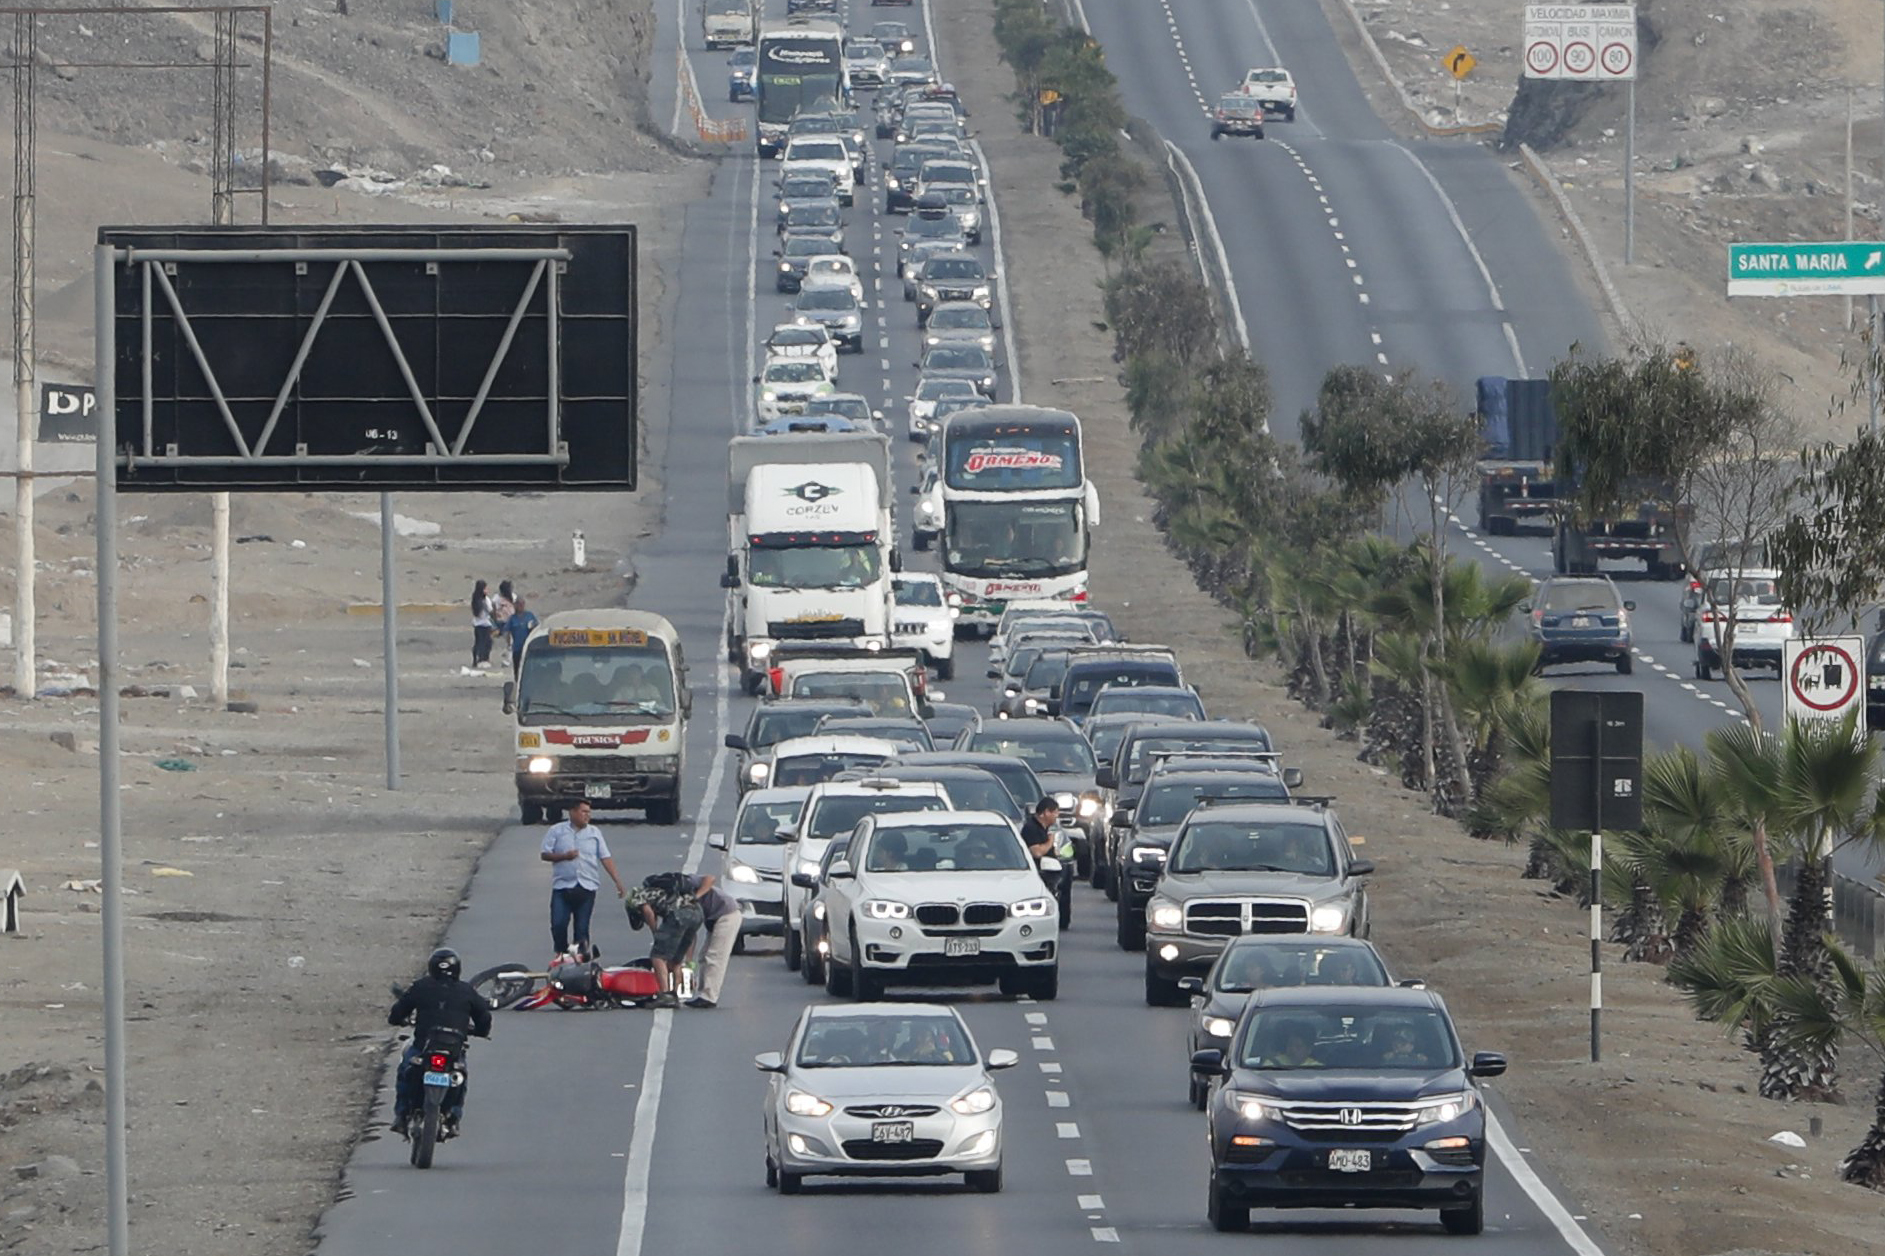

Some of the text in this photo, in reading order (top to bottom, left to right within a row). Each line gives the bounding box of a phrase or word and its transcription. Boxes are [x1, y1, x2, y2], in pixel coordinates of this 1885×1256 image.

[1530, 8, 1587, 19] VELOCIDAD
[1567, 25, 1590, 37] BUS
[1532, 49, 1552, 63] 100
[1571, 49, 1590, 63] 90
[1738, 252, 1848, 271] SANTA MARIA
